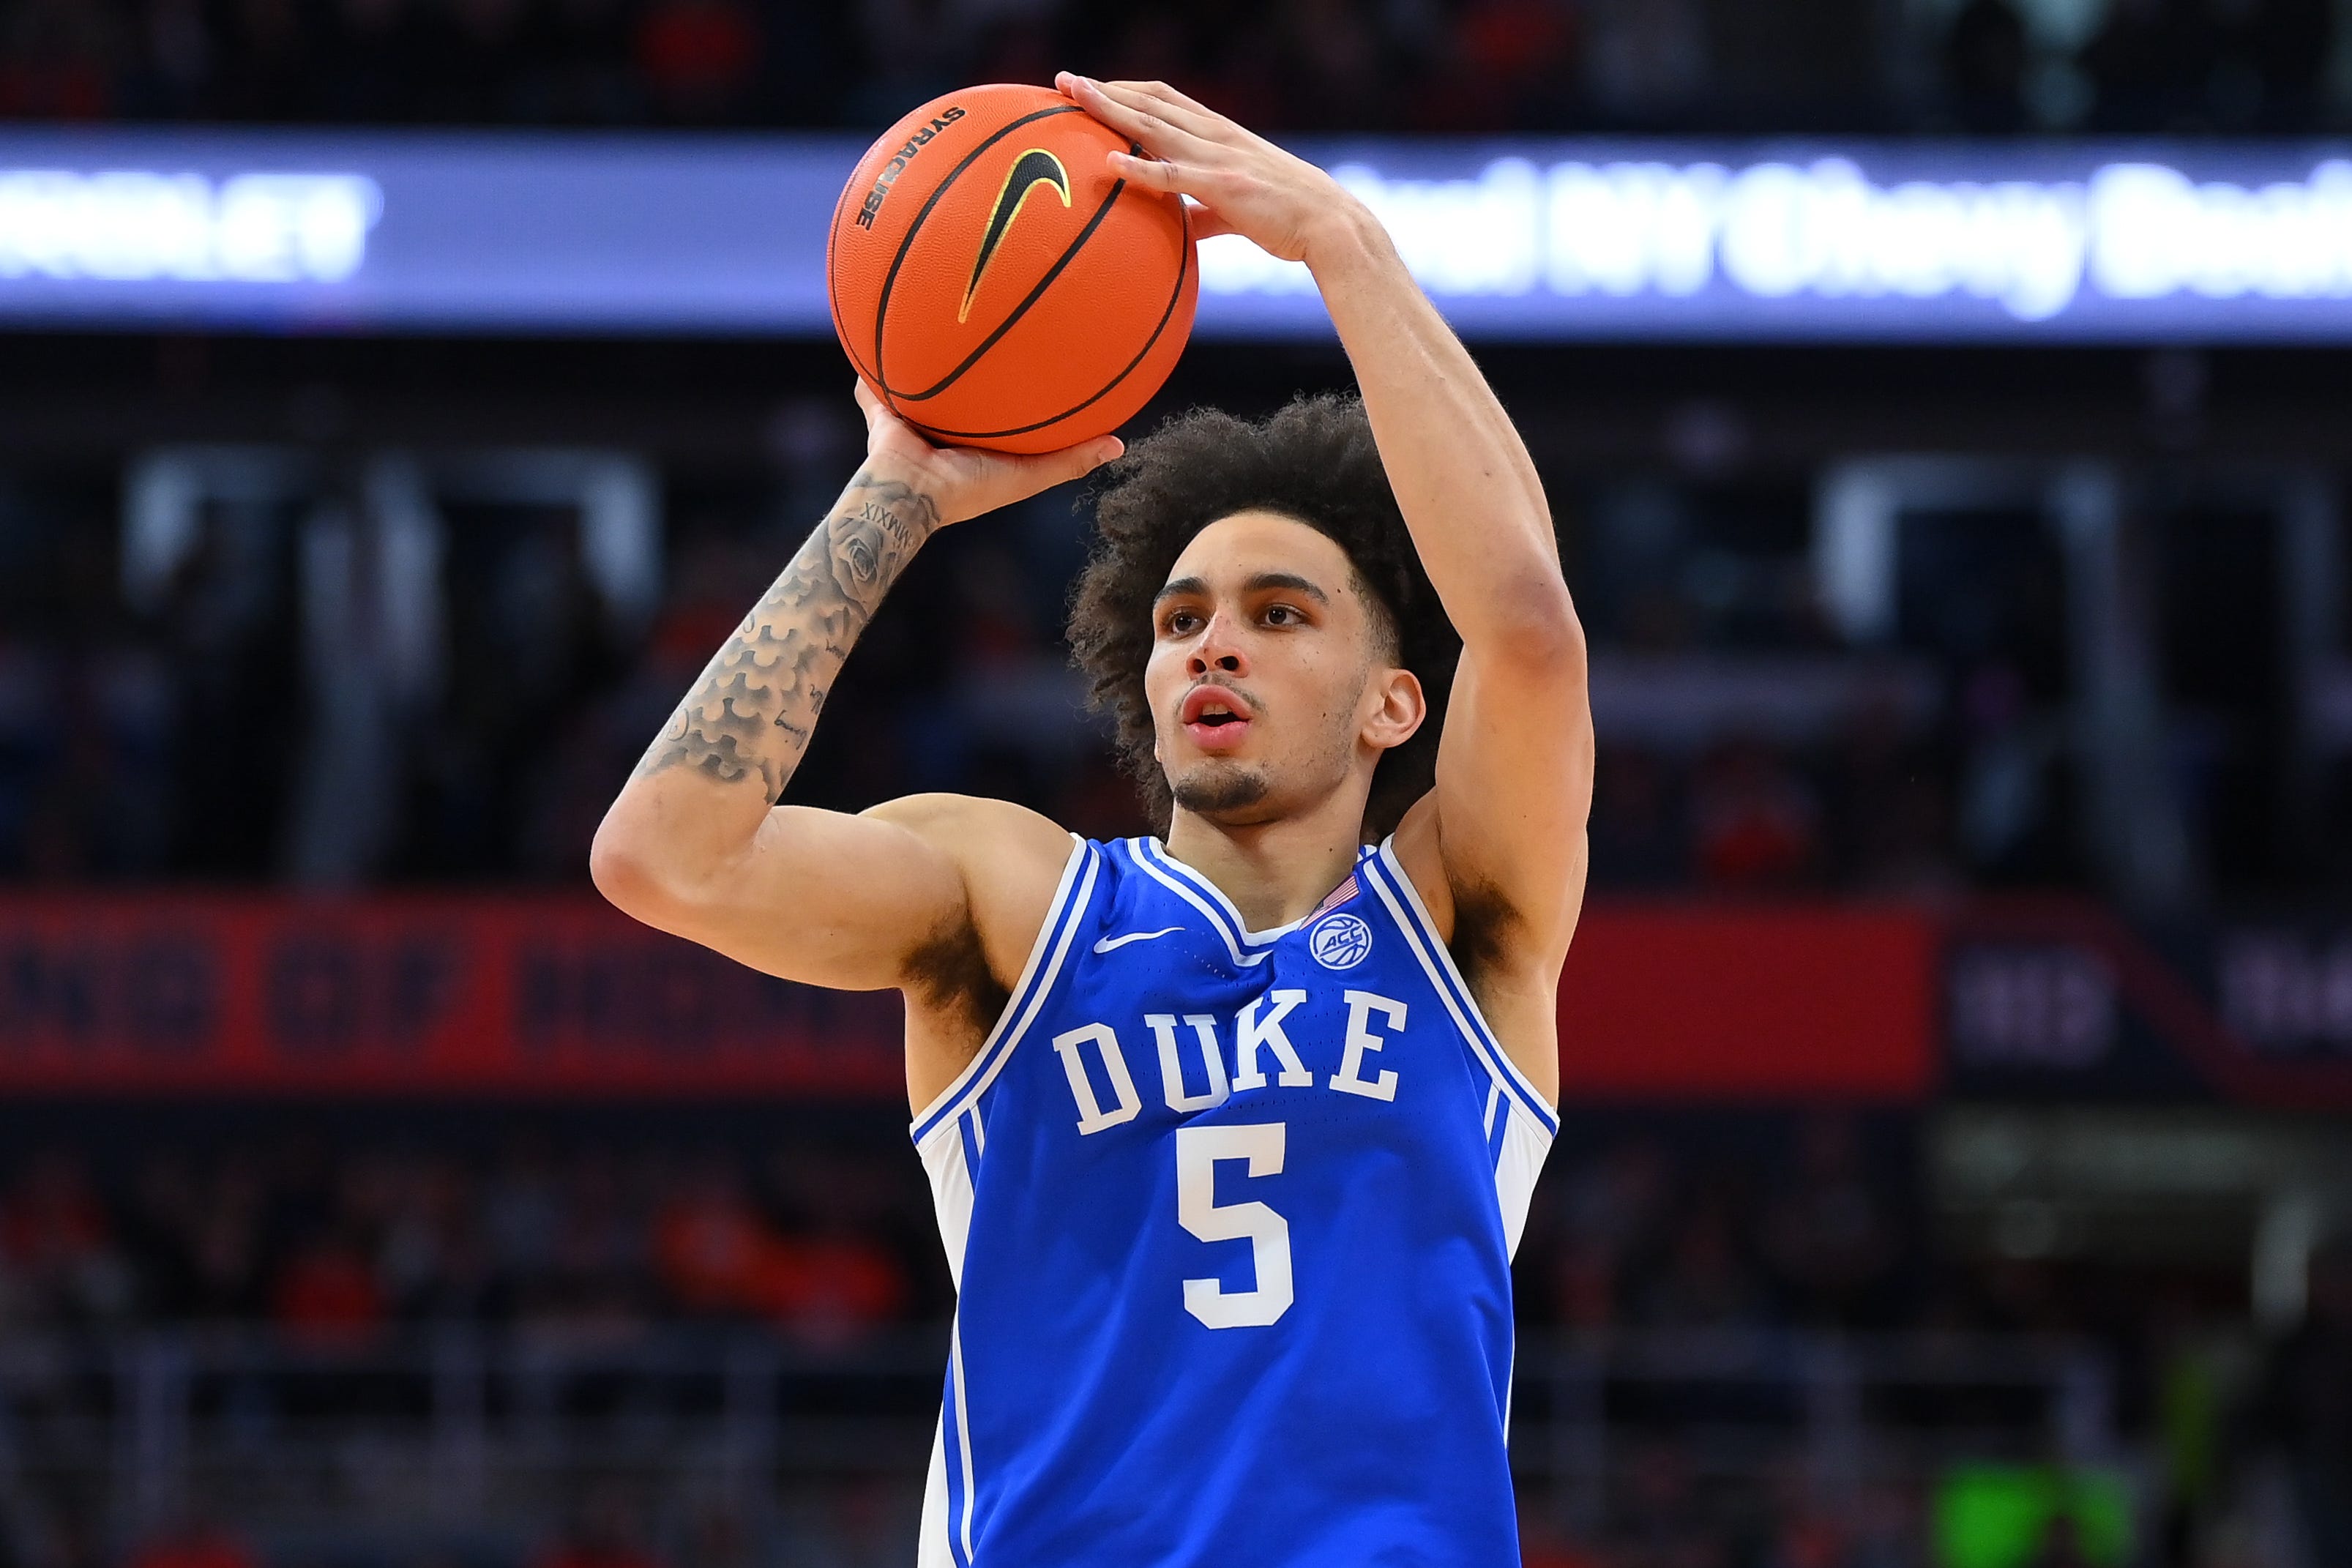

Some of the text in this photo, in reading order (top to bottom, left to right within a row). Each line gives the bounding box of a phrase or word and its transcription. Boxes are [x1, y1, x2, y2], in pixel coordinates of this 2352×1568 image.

[855, 106, 966, 231] SYRACUSE
[1322, 925, 1364, 951] ACC
[1052, 989, 1408, 1136] DUKE
[1176, 1121, 1294, 1330] 5
